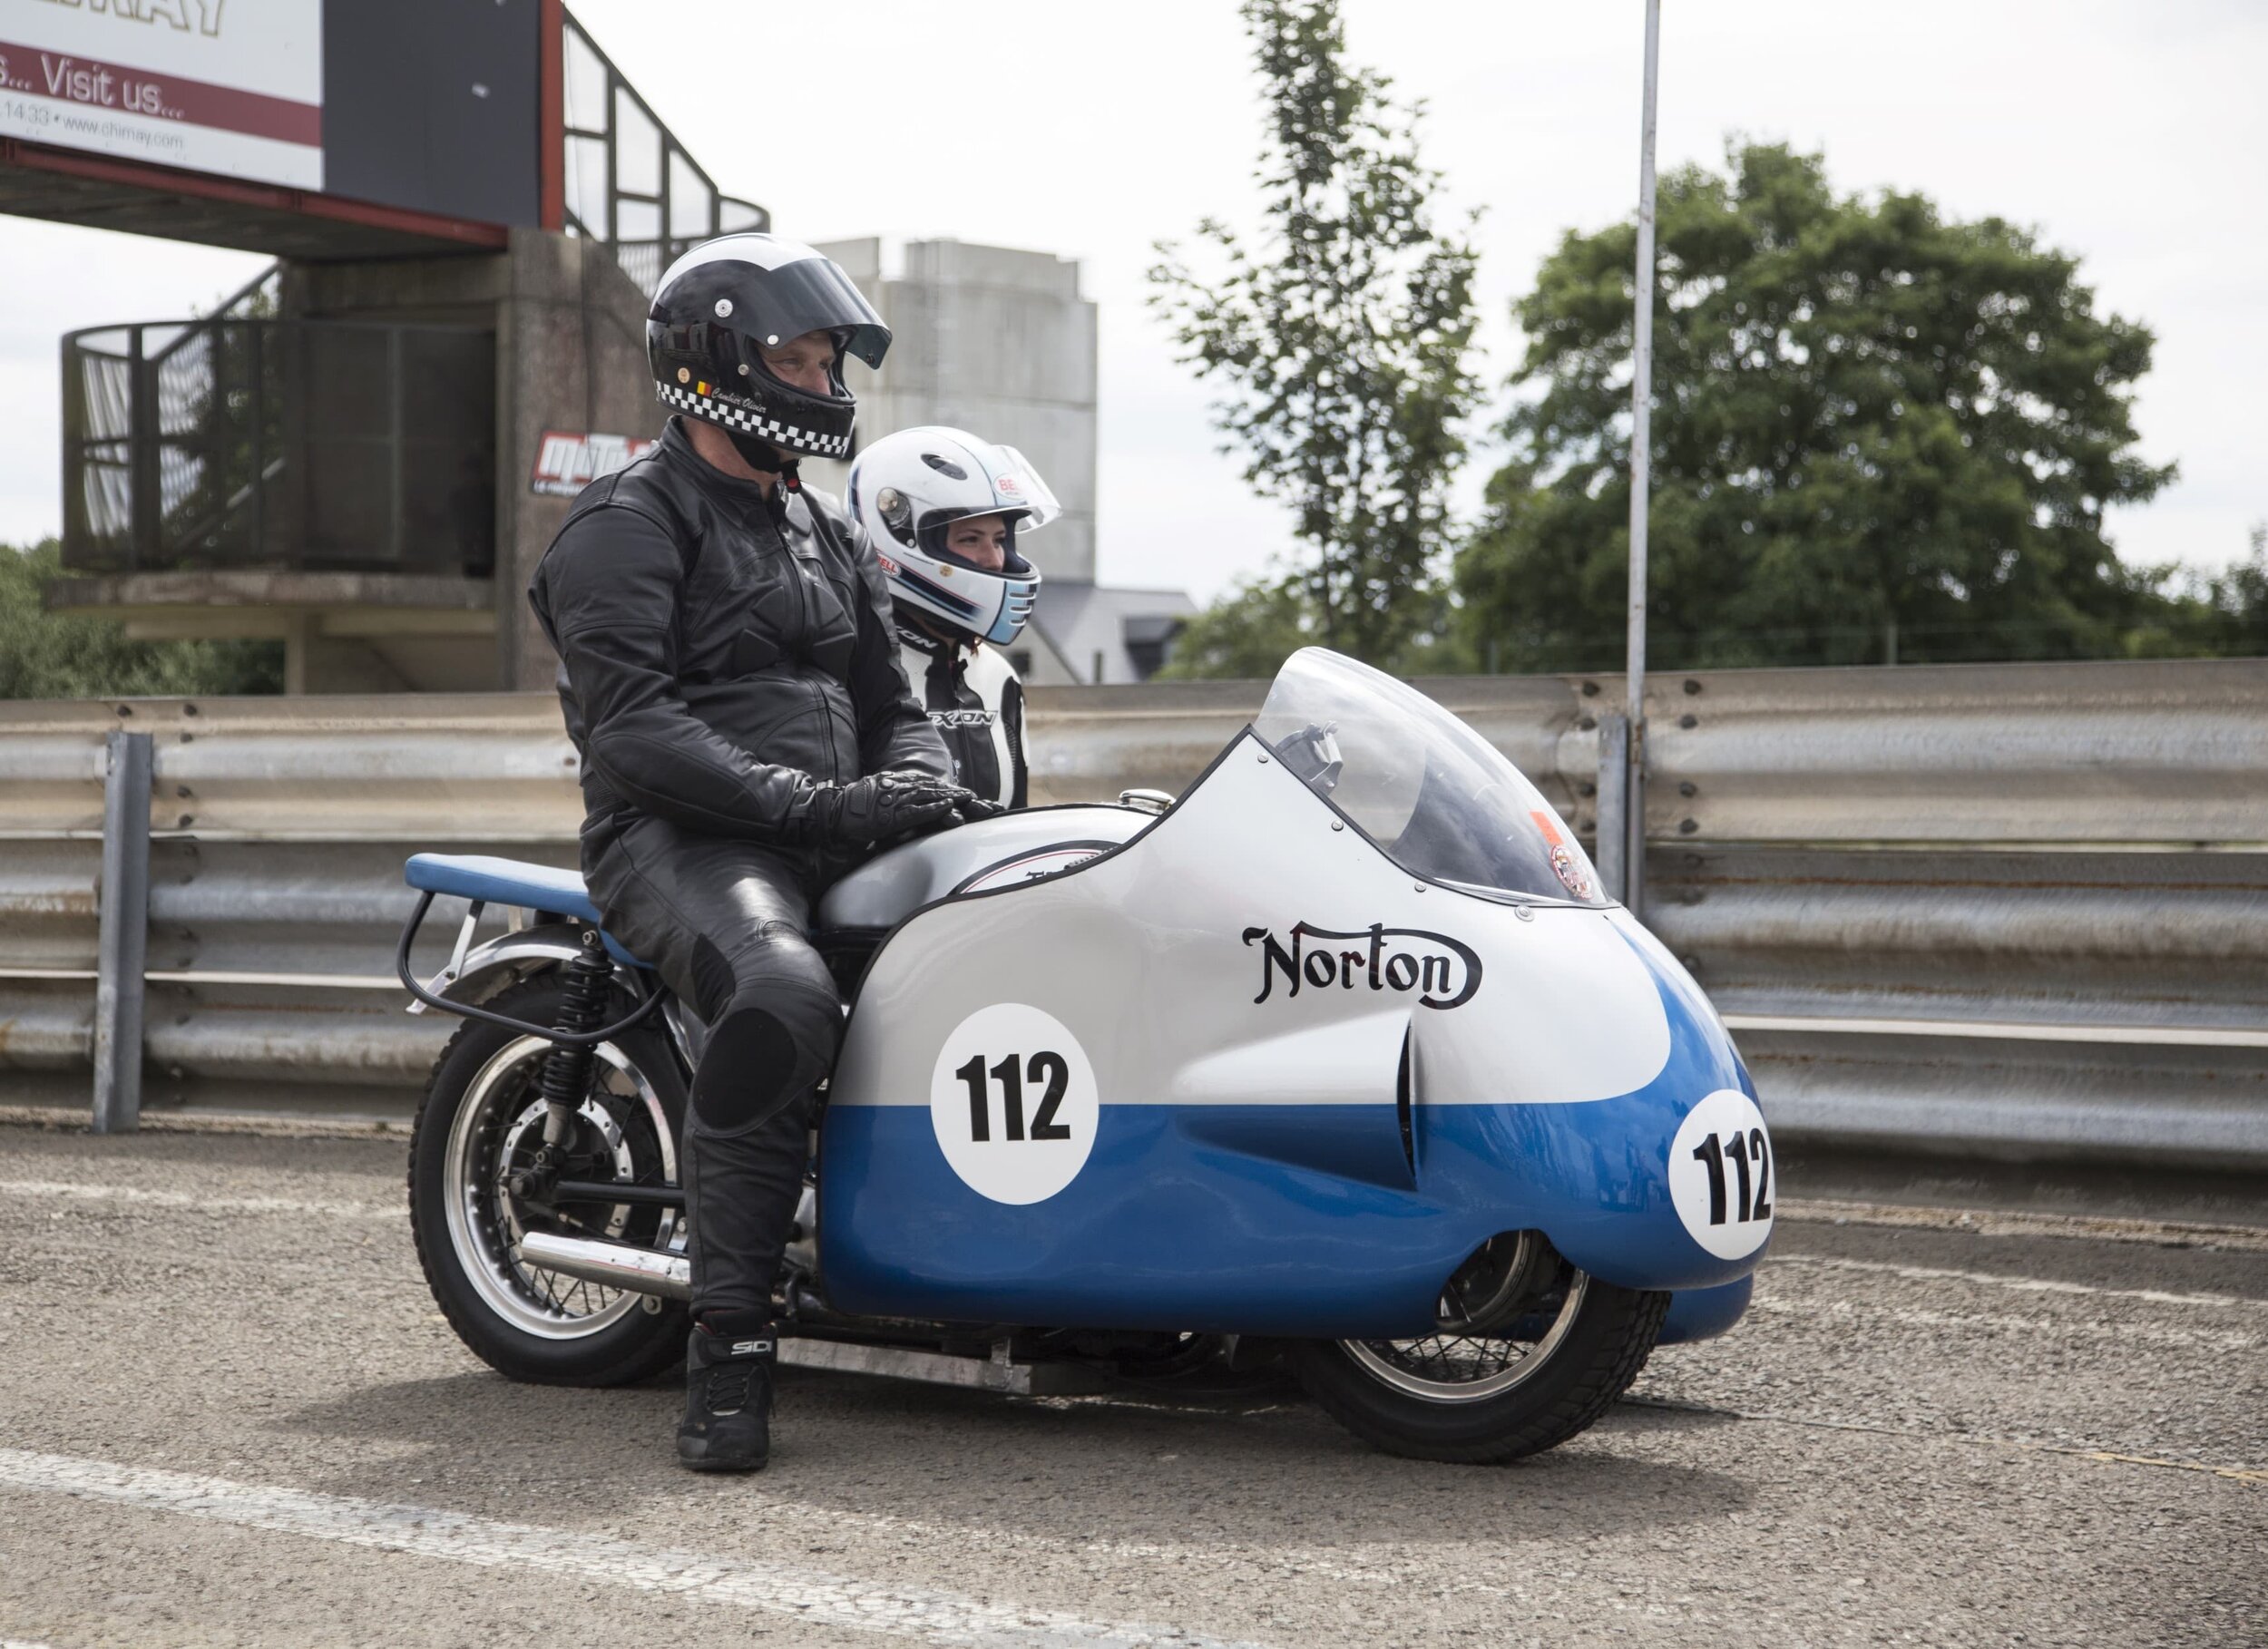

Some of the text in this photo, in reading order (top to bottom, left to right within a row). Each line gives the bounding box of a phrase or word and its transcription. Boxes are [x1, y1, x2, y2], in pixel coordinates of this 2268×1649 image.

[41, 52, 116, 106] Visit
[123, 79, 185, 120] us...
[63, 116, 184, 149] www.chimay.com
[1242, 921, 1482, 1010] Norton
[955, 1050, 1070, 1142] 112
[1693, 1127, 1771, 1225] 112
